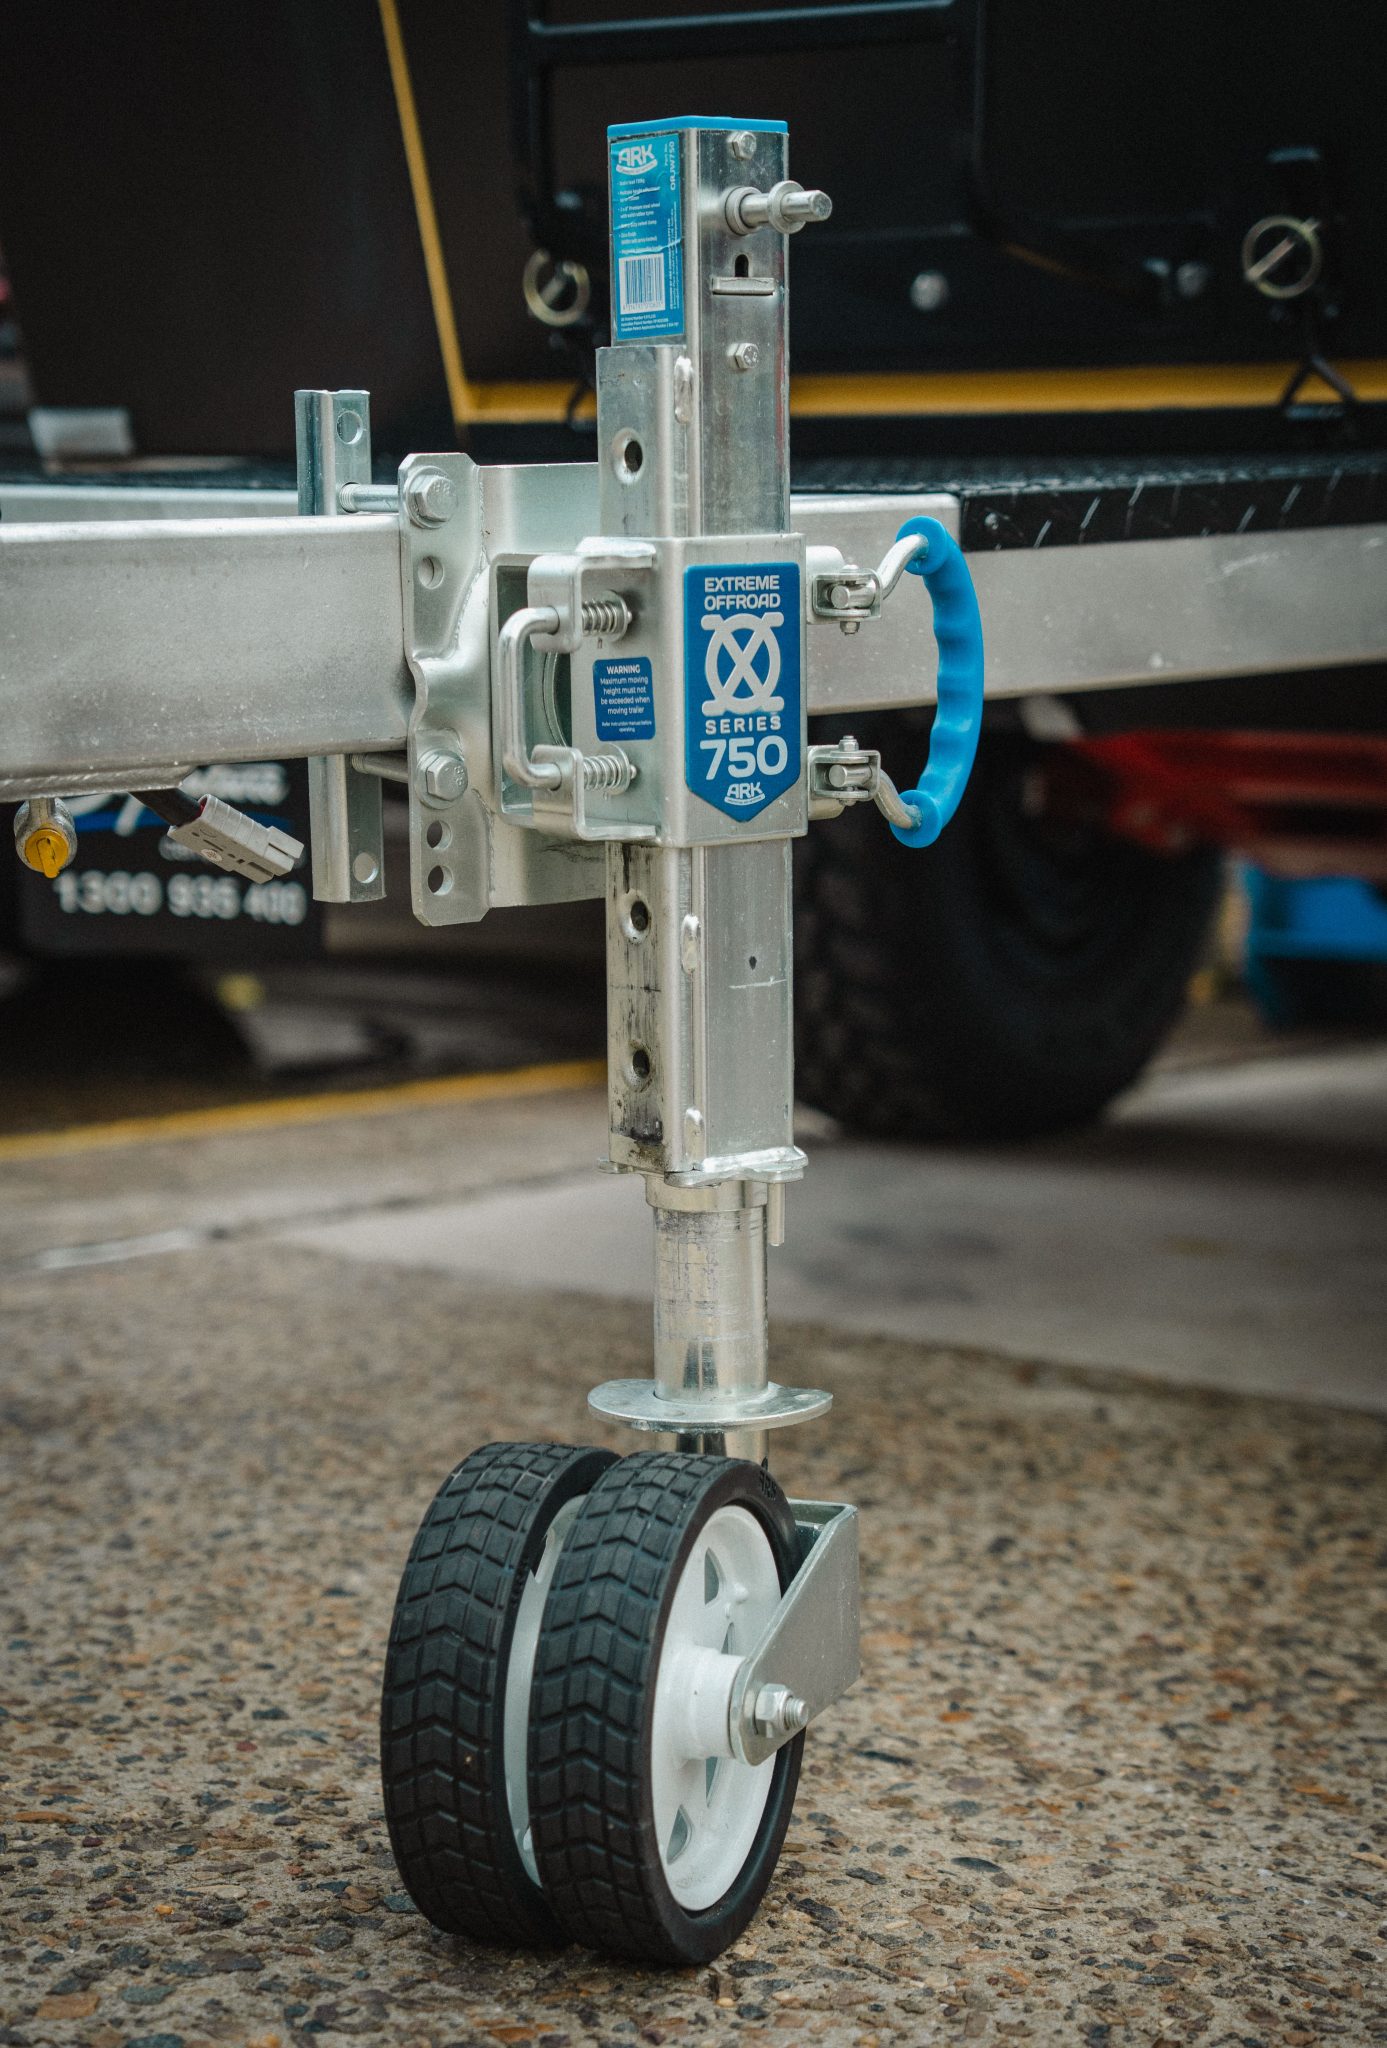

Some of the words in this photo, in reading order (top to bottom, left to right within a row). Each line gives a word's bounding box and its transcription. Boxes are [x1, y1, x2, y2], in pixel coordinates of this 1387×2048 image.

[618, 144, 655, 167] ARK
[704, 575, 780, 592] EXTREME
[704, 593, 780, 611] OFFROAD
[606, 664, 640, 674] WARNING
[628, 676, 648, 684] moving
[604, 688, 621, 696] height
[608, 696, 634, 704] exceeded
[608, 708, 628, 716] moving
[705, 715, 782, 735] SERIES
[700, 735, 788, 780] 750
[726, 781, 764, 800] ARK
